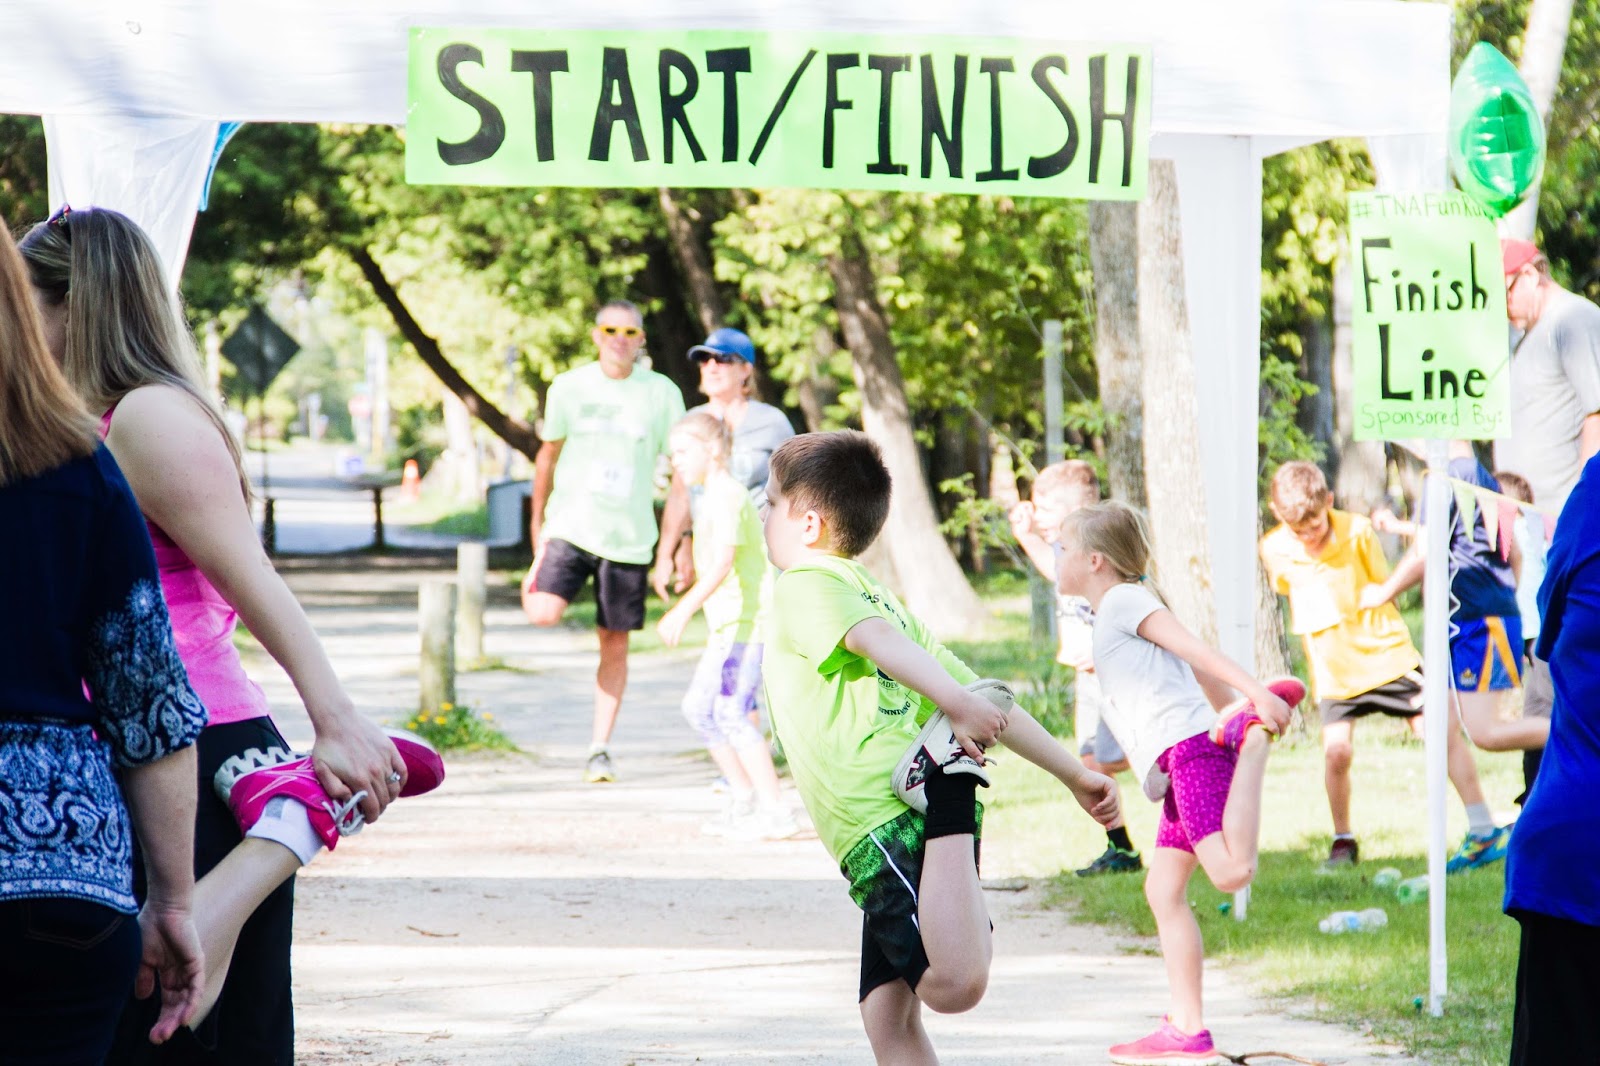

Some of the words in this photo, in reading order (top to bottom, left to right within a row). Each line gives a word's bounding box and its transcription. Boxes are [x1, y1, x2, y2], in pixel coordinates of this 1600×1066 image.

[436, 42, 1140, 188] START/FINISH
[1352, 193, 1487, 219] #TNAFunRu
[1361, 237, 1489, 313] Finish
[1378, 323, 1487, 401] Line
[1361, 400, 1460, 434] Sponsored
[1471, 403, 1503, 433] By:
